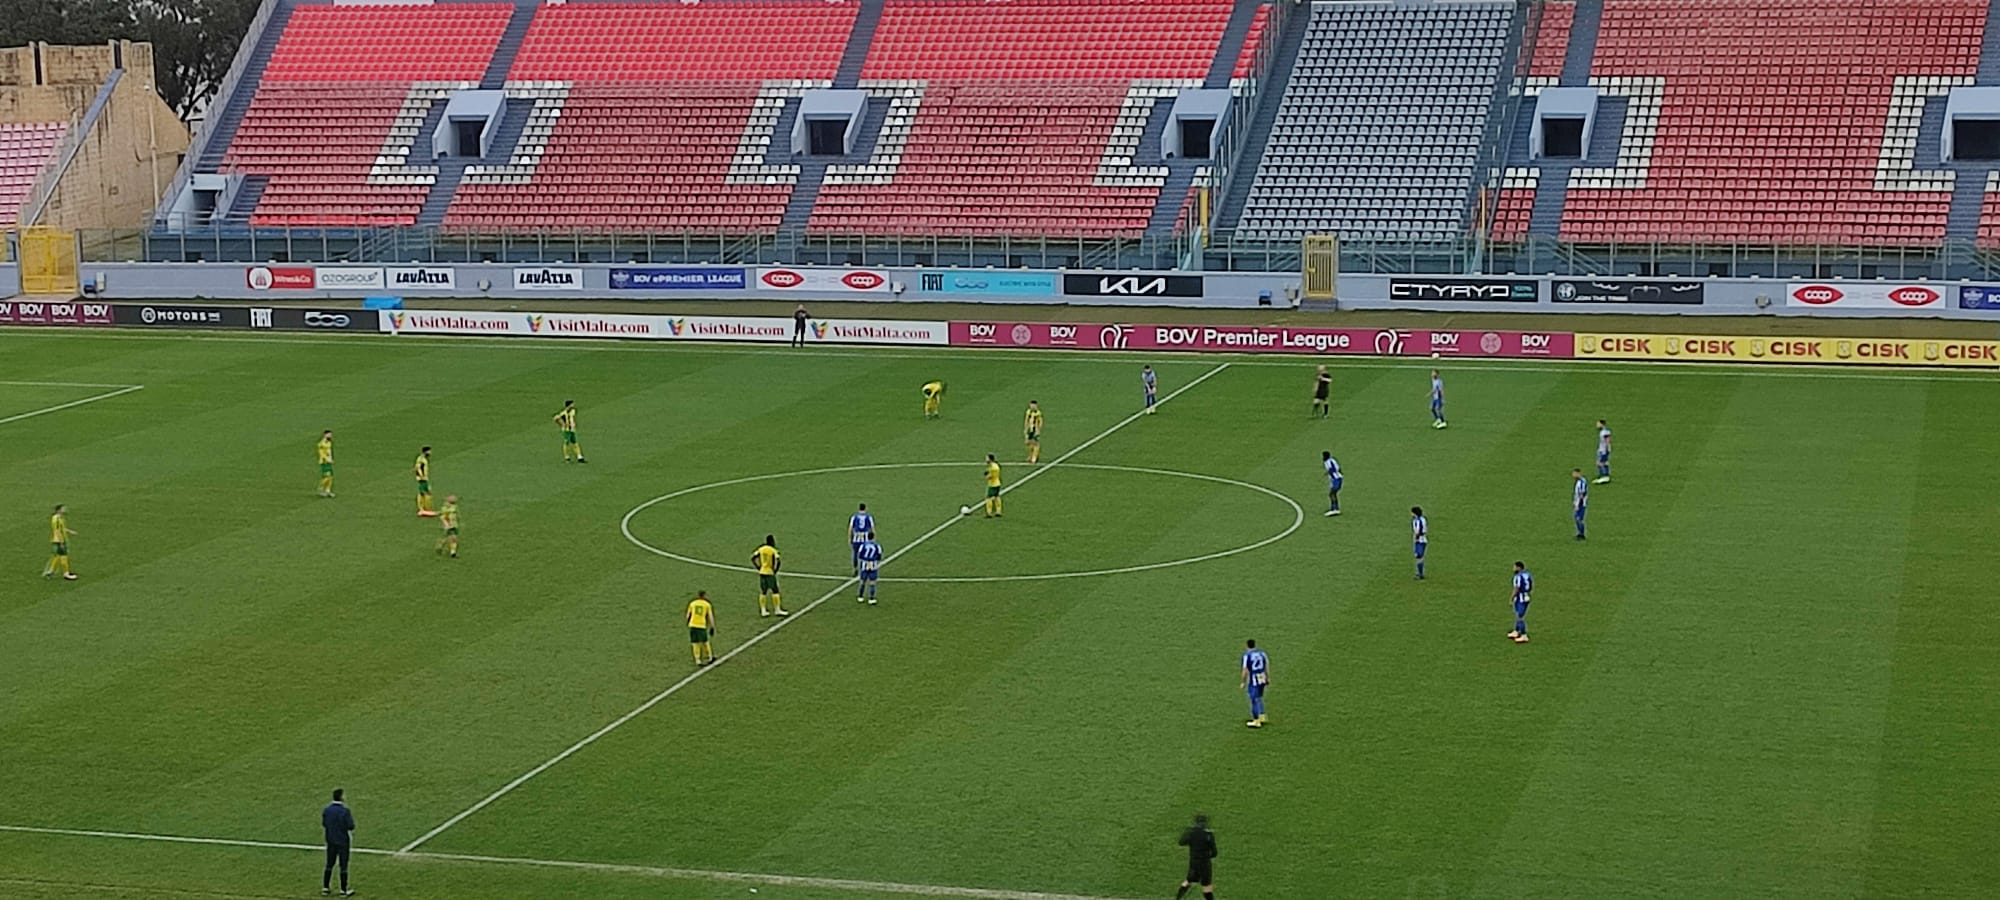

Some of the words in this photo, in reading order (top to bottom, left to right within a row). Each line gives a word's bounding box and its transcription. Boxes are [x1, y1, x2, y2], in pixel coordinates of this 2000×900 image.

[396, 269, 450, 284] LAVAZZA
[519, 270, 574, 285] LAVAZZA
[707, 275, 742, 284] LEAGUE
[771, 274, 796, 288] coop
[851, 275, 876, 290] coop
[922, 274, 944, 291] FIAT
[1803, 289, 1833, 302] coop
[1899, 291, 1929, 304] coop
[19, 303, 44, 316] BOV
[51, 304, 76, 317] BOV
[83, 304, 108, 318] BOV
[157, 311, 207, 321] MOTORS
[250, 308, 272, 328] FIAT
[410, 316, 508, 330] VisitMalta.com
[549, 319, 650, 333] VisitMalta.com
[690, 323, 785, 336] VisitMalta.com
[833, 326, 930, 340] VisitMalta.com
[970, 324, 996, 337] BOV
[1050, 326, 1077, 338] BOV
[1156, 328, 1198, 344] BOV
[1204, 329, 1278, 346] Premier
[1282, 330, 1350, 350] League
[1431, 333, 1459, 346] BOV
[1521, 335, 1550, 347] BOV
[1601, 338, 1651, 354] CISK
[1685, 340, 1735, 356] CISK
[1770, 341, 1822, 357] CISK
[1856, 343, 1909, 359] CISK
[1944, 345, 1997, 361] CISK
[865, 545, 876, 558] 77
